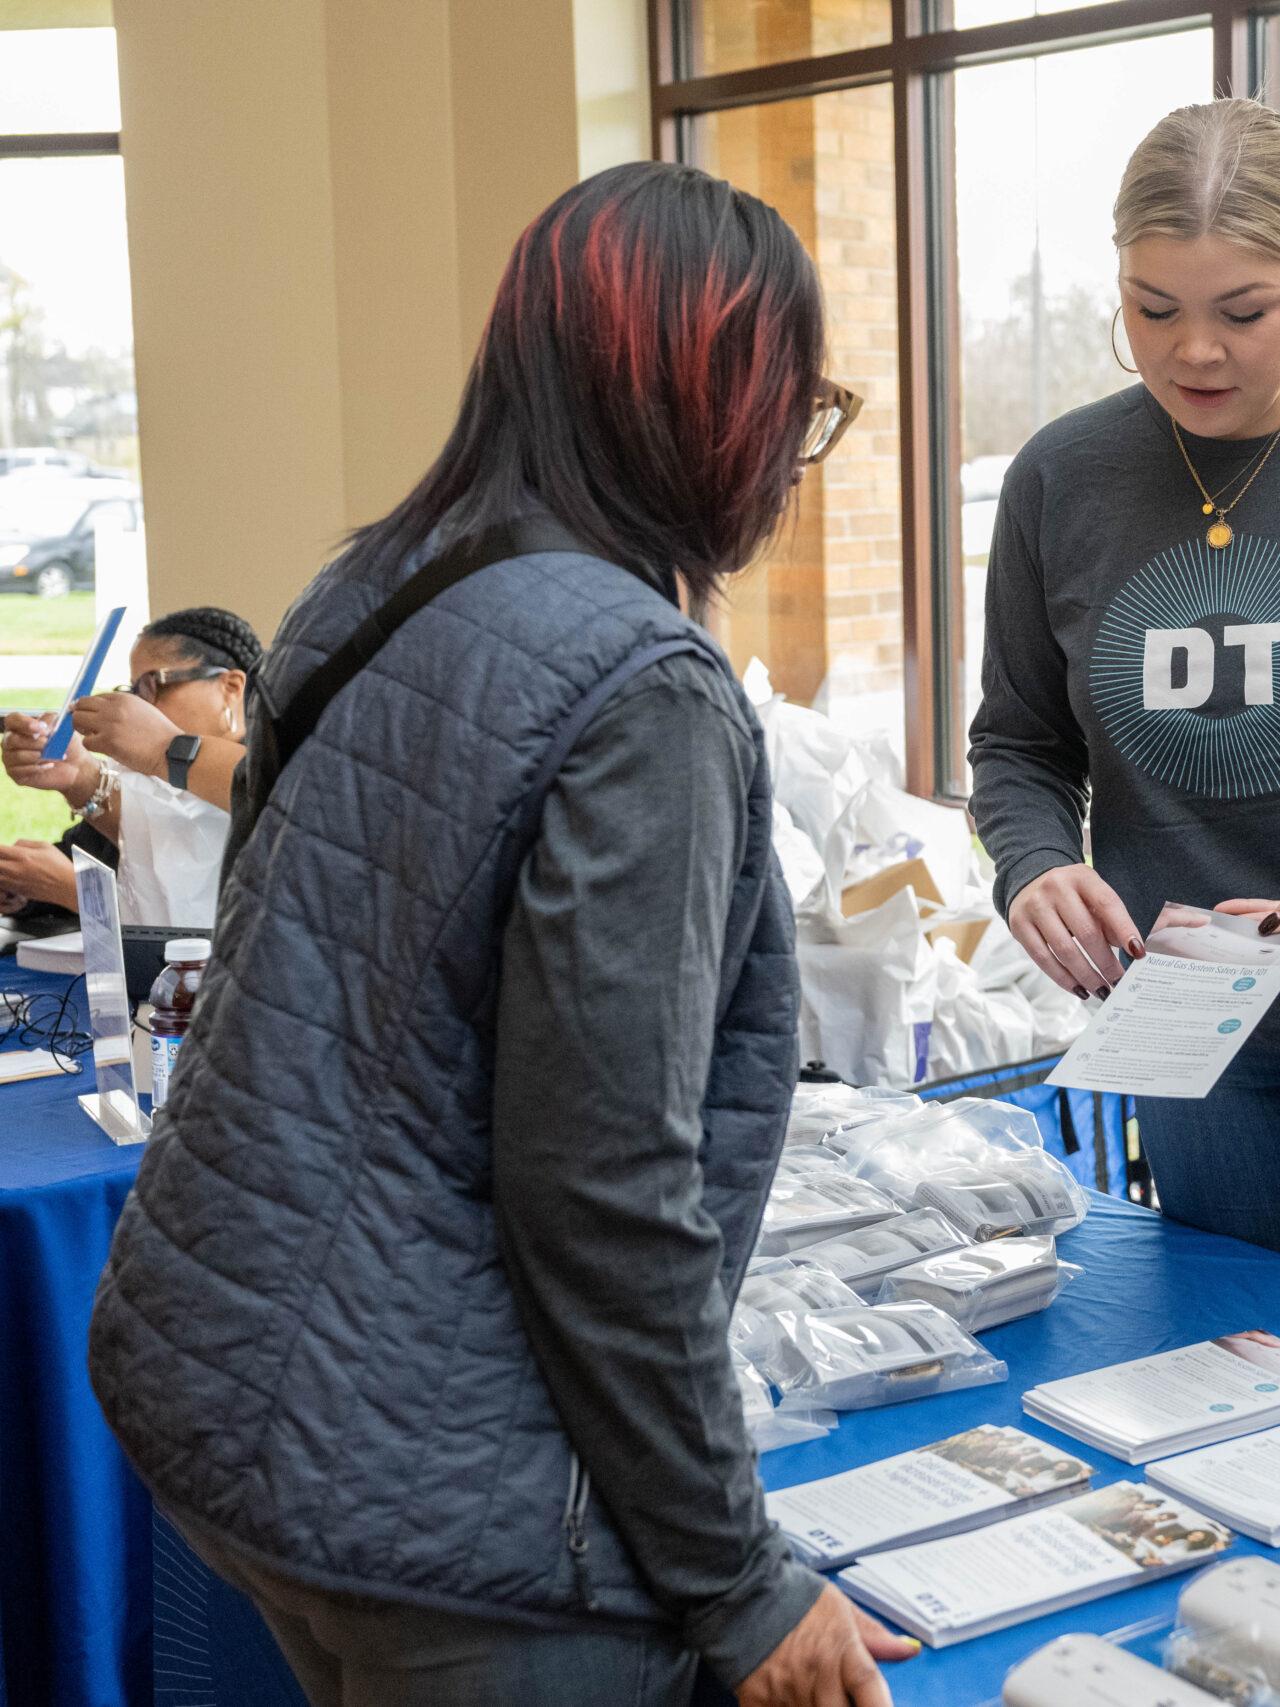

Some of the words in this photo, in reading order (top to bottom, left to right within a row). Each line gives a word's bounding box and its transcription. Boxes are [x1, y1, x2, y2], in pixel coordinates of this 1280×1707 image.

[1146, 956, 1173, 968] Natural
[1173, 960, 1187, 970] Gas
[1187, 962, 1216, 974] System
[1215, 965, 1238, 976] Safety
[808, 1528, 843, 1548] DTE
